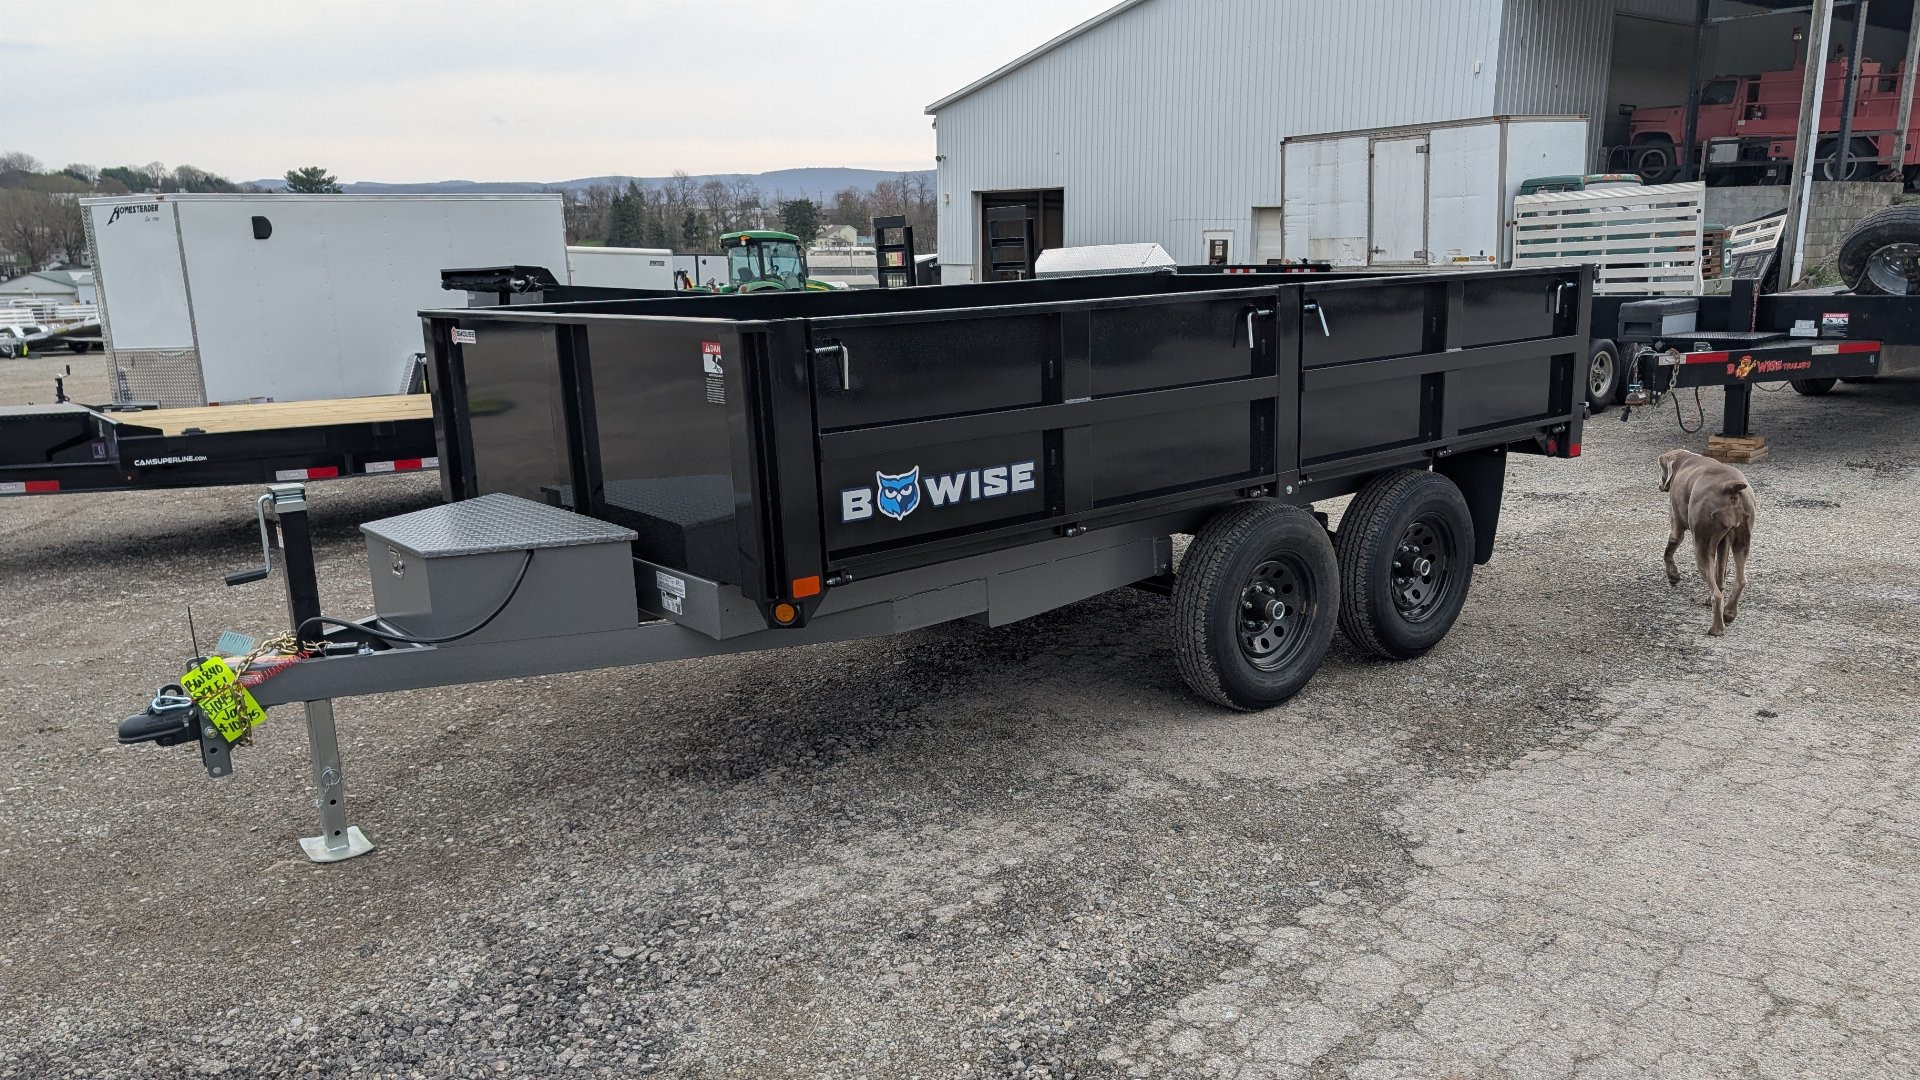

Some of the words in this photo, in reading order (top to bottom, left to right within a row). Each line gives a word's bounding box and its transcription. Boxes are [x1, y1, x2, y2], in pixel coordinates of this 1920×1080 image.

[107, 203, 159, 226] HOMESTEADER
[1757, 359, 1783, 374] WISE
[841, 487, 873, 522] B
[923, 460, 1036, 507] WISE
